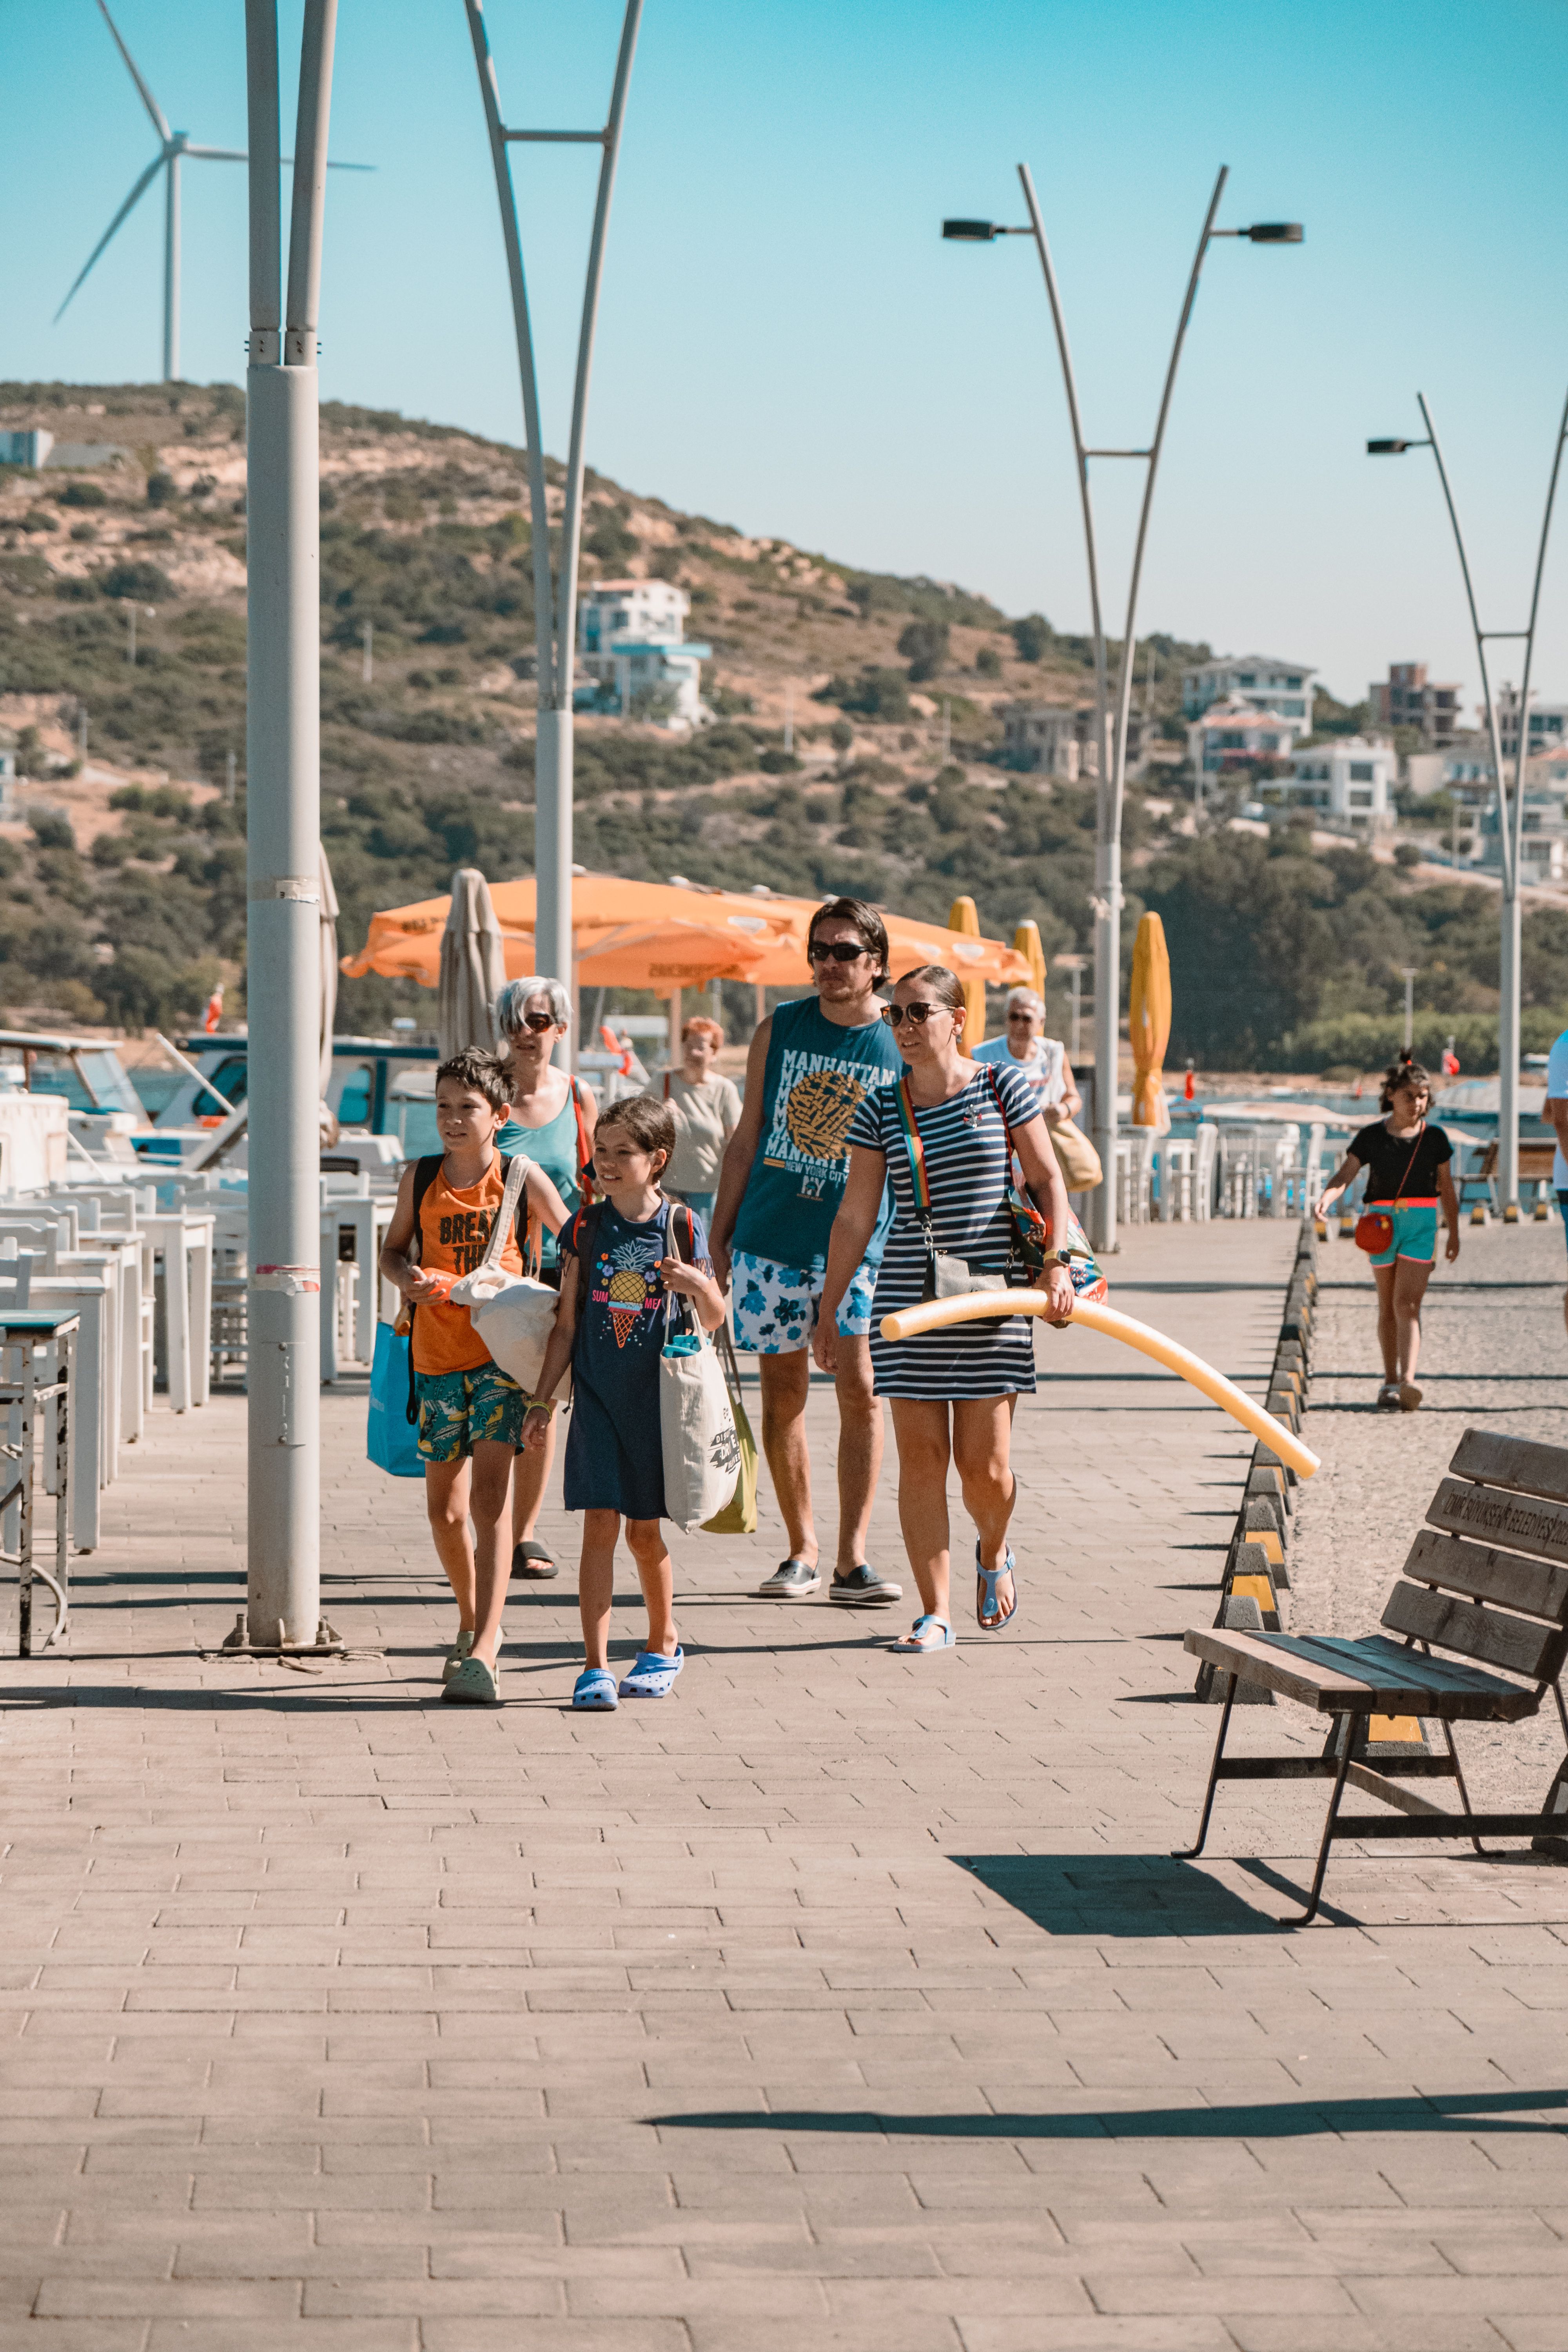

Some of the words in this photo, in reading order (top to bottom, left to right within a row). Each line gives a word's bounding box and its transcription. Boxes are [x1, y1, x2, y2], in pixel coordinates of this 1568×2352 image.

[784, 1049, 895, 1086] MANHATTAN
[785, 1160, 804, 1173] NEW
[805, 1164, 828, 1179] YORK
[829, 1170, 849, 1184] CITY
[592, 1290, 608, 1303] SUM
